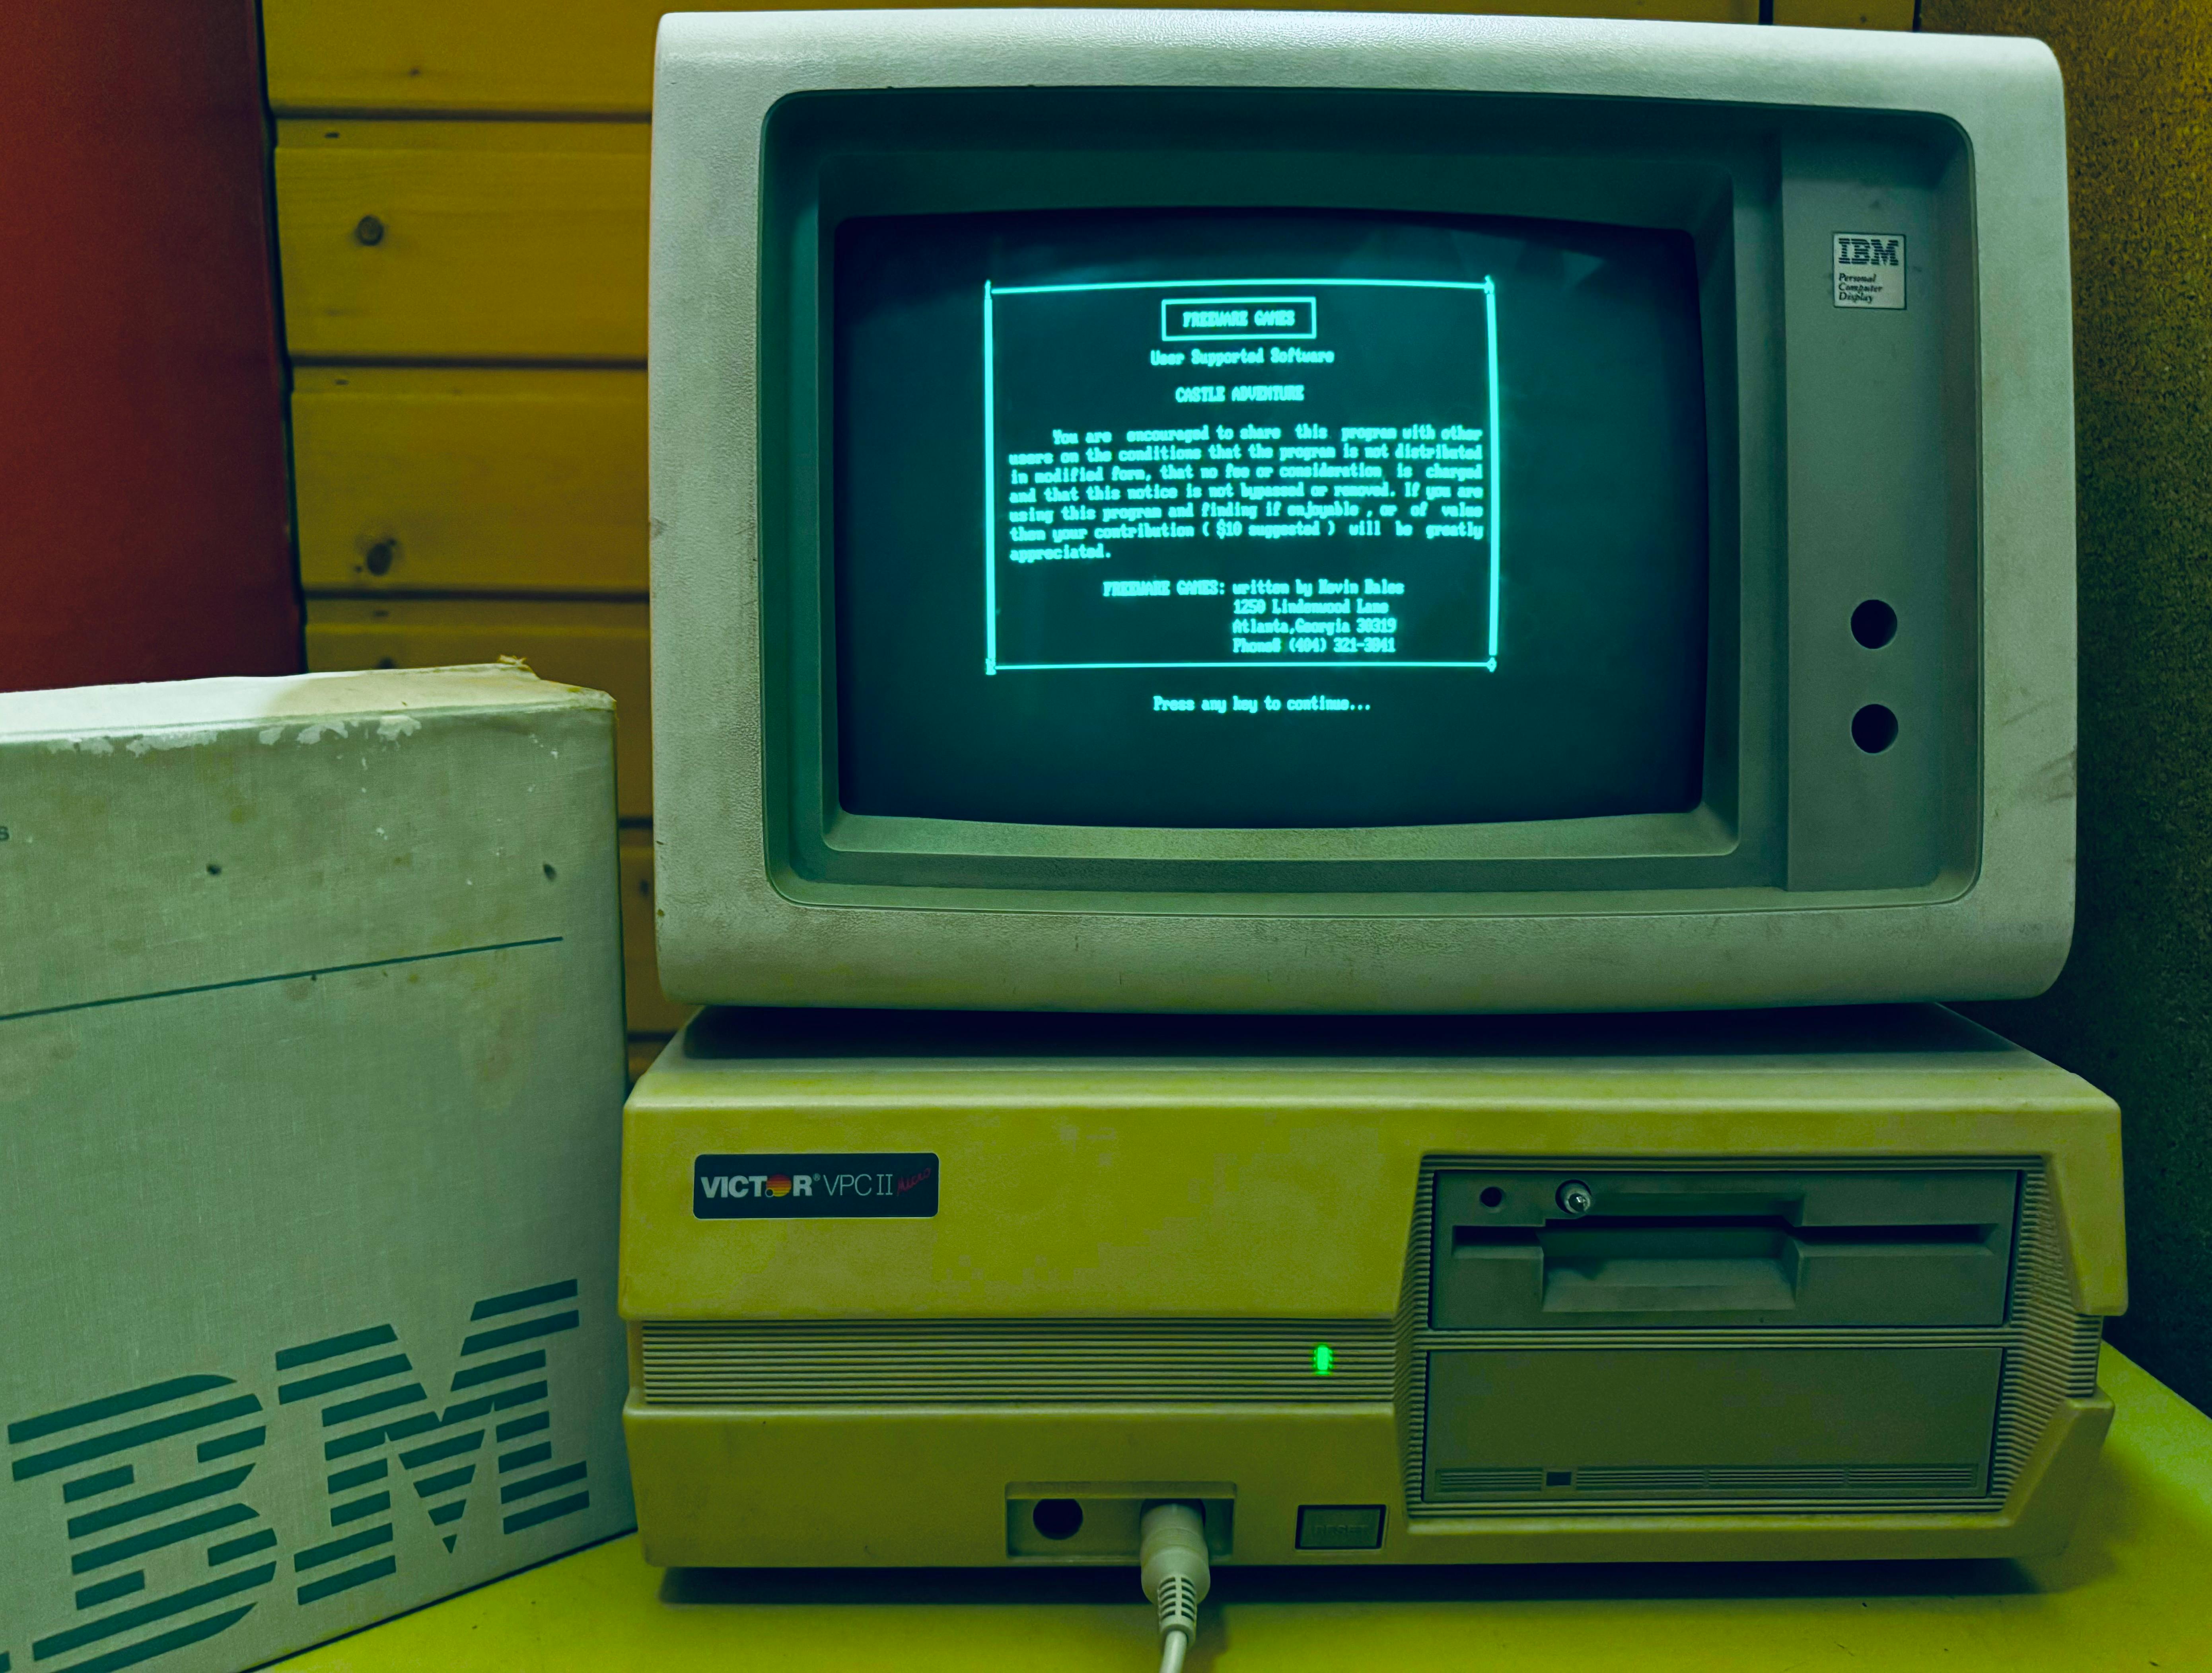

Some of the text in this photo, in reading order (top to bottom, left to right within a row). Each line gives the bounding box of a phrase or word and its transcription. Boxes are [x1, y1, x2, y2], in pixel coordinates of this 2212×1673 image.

[1838, 238, 1899, 266] IBM
[1838, 273, 1877, 282] Personal
[1838, 282, 1883, 293] Computer
[1838, 292, 1873, 304] Display
[1183, 310, 1295, 327] FREEWARE GAMES
[1151, 347, 1335, 367] User Supported Software
[1175, 385, 1304, 403] CASTLE ADVENTURE
[1053, 423, 1483, 444] You are encouraged to share this program with other
[1009, 442, 1483, 465] users on the conditions that the program is not distributed
[1011, 462, 1483, 484] in modified form, that no fee or consideration is charged
[1009, 481, 1483, 503] and that this notice is not bypassed or removed. If you are
[1009, 507, 1054, 524] using
[1061, 505, 1096, 520] this
[1102, 507, 1162, 522] program
[1168, 502, 1194, 518] and
[1202, 501, 1258, 519] finding
[1266, 501, 1282, 516] if
[1287, 500, 1360, 519] enjoyable
[1379, 504, 1397, 516] or
[1410, 501, 1428, 517] of
[1441, 501, 1483, 518] value
[1010, 526, 1046, 541] then
[1052, 528, 1088, 543] your
[1094, 522, 1194, 539] contribution
[1216, 518, 1242, 539] $10
[1248, 520, 1320, 539] suggested
[1349, 520, 1381, 536] will
[1395, 520, 1413, 536] be
[1426, 521, 1484, 539] greatly
[1010, 543, 1111, 563] appreciated.
[1103, 580, 1170, 596] FREEWARE
[1233, 579, 1289, 594] written
[1296, 579, 1313, 597] by
[1356, 598, 1389, 613] Lane
[1289, 637, 1327, 652] (404)
[1153, 696, 1195, 711] Press
[1201, 700, 1226, 713] any
[1233, 695, 1258, 713] key
[1264, 695, 1281, 710] to
[823, 1174, 872, 1196] VPC
[876, 1174, 894, 1195] II
[0, 1278, 590, 1673] BM
